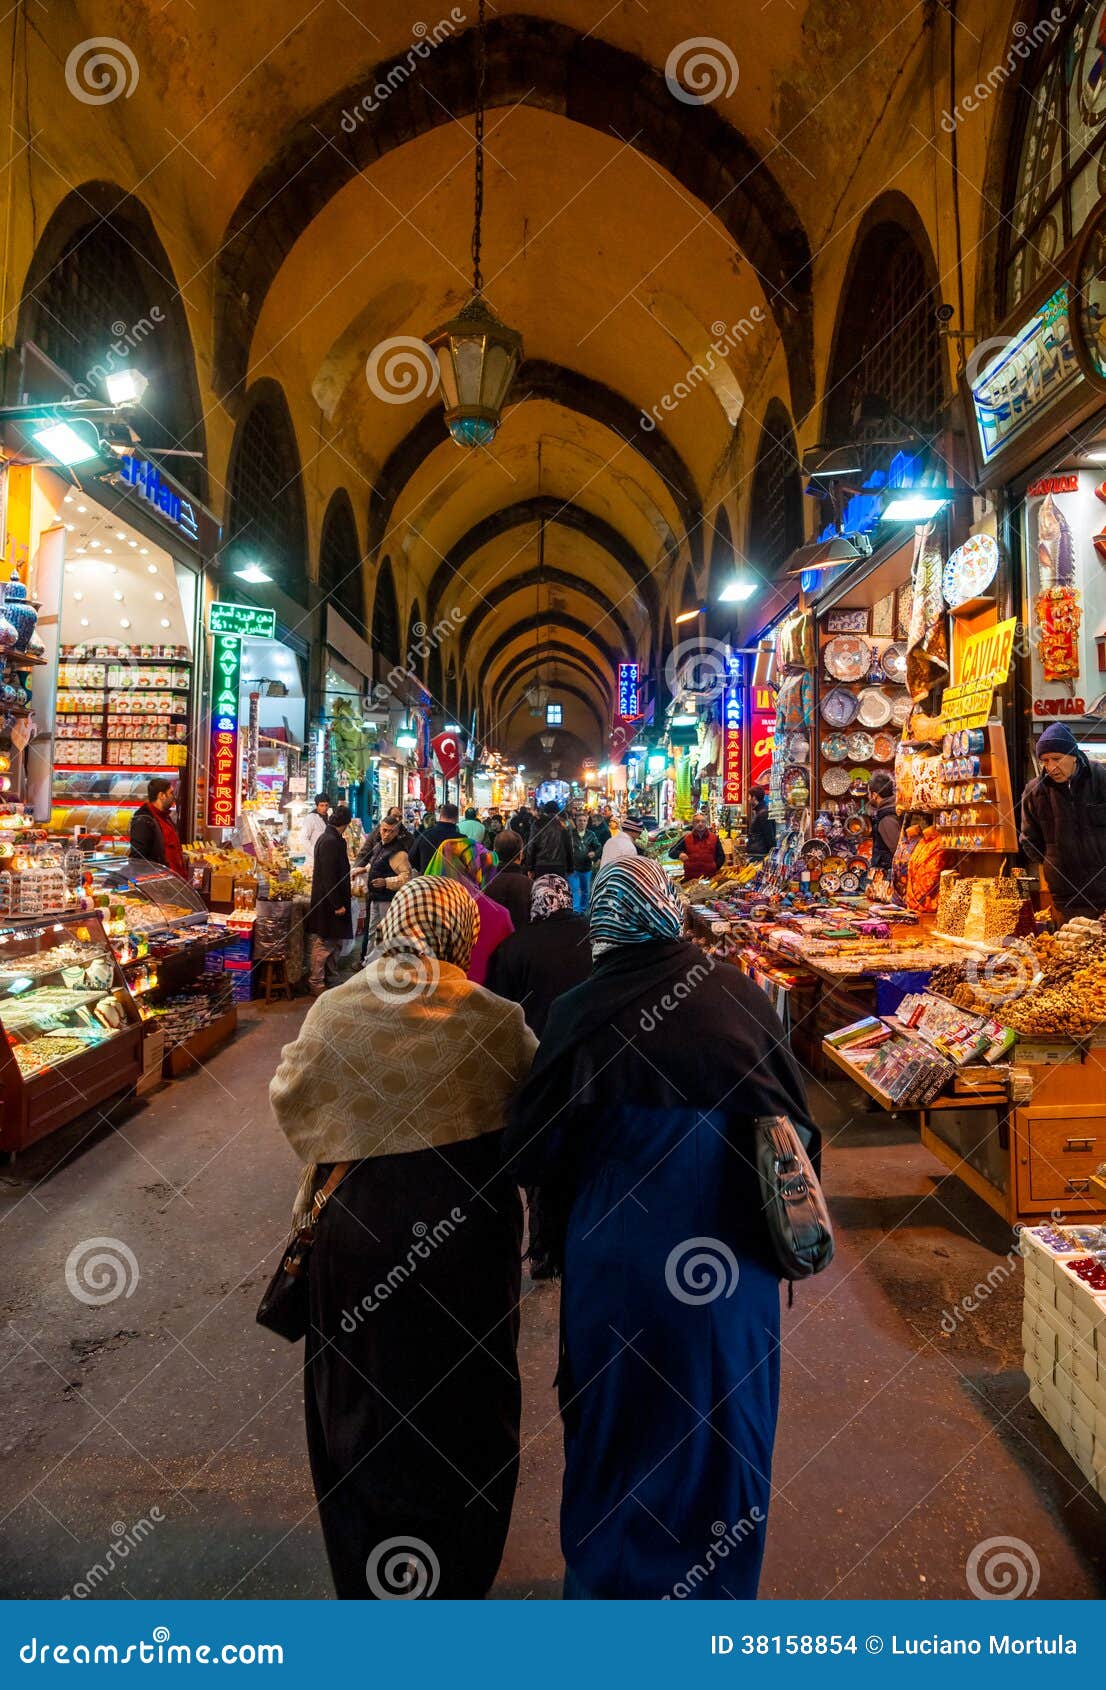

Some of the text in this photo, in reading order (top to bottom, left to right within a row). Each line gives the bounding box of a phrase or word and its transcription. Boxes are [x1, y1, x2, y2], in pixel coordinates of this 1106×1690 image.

[961, 629, 1012, 684] CAVIAR
[213, 635, 239, 827] CAVIAR & SAFFRON
[1033, 697, 1086, 717] CAVIAR
[727, 730, 740, 802] SAFFRON
